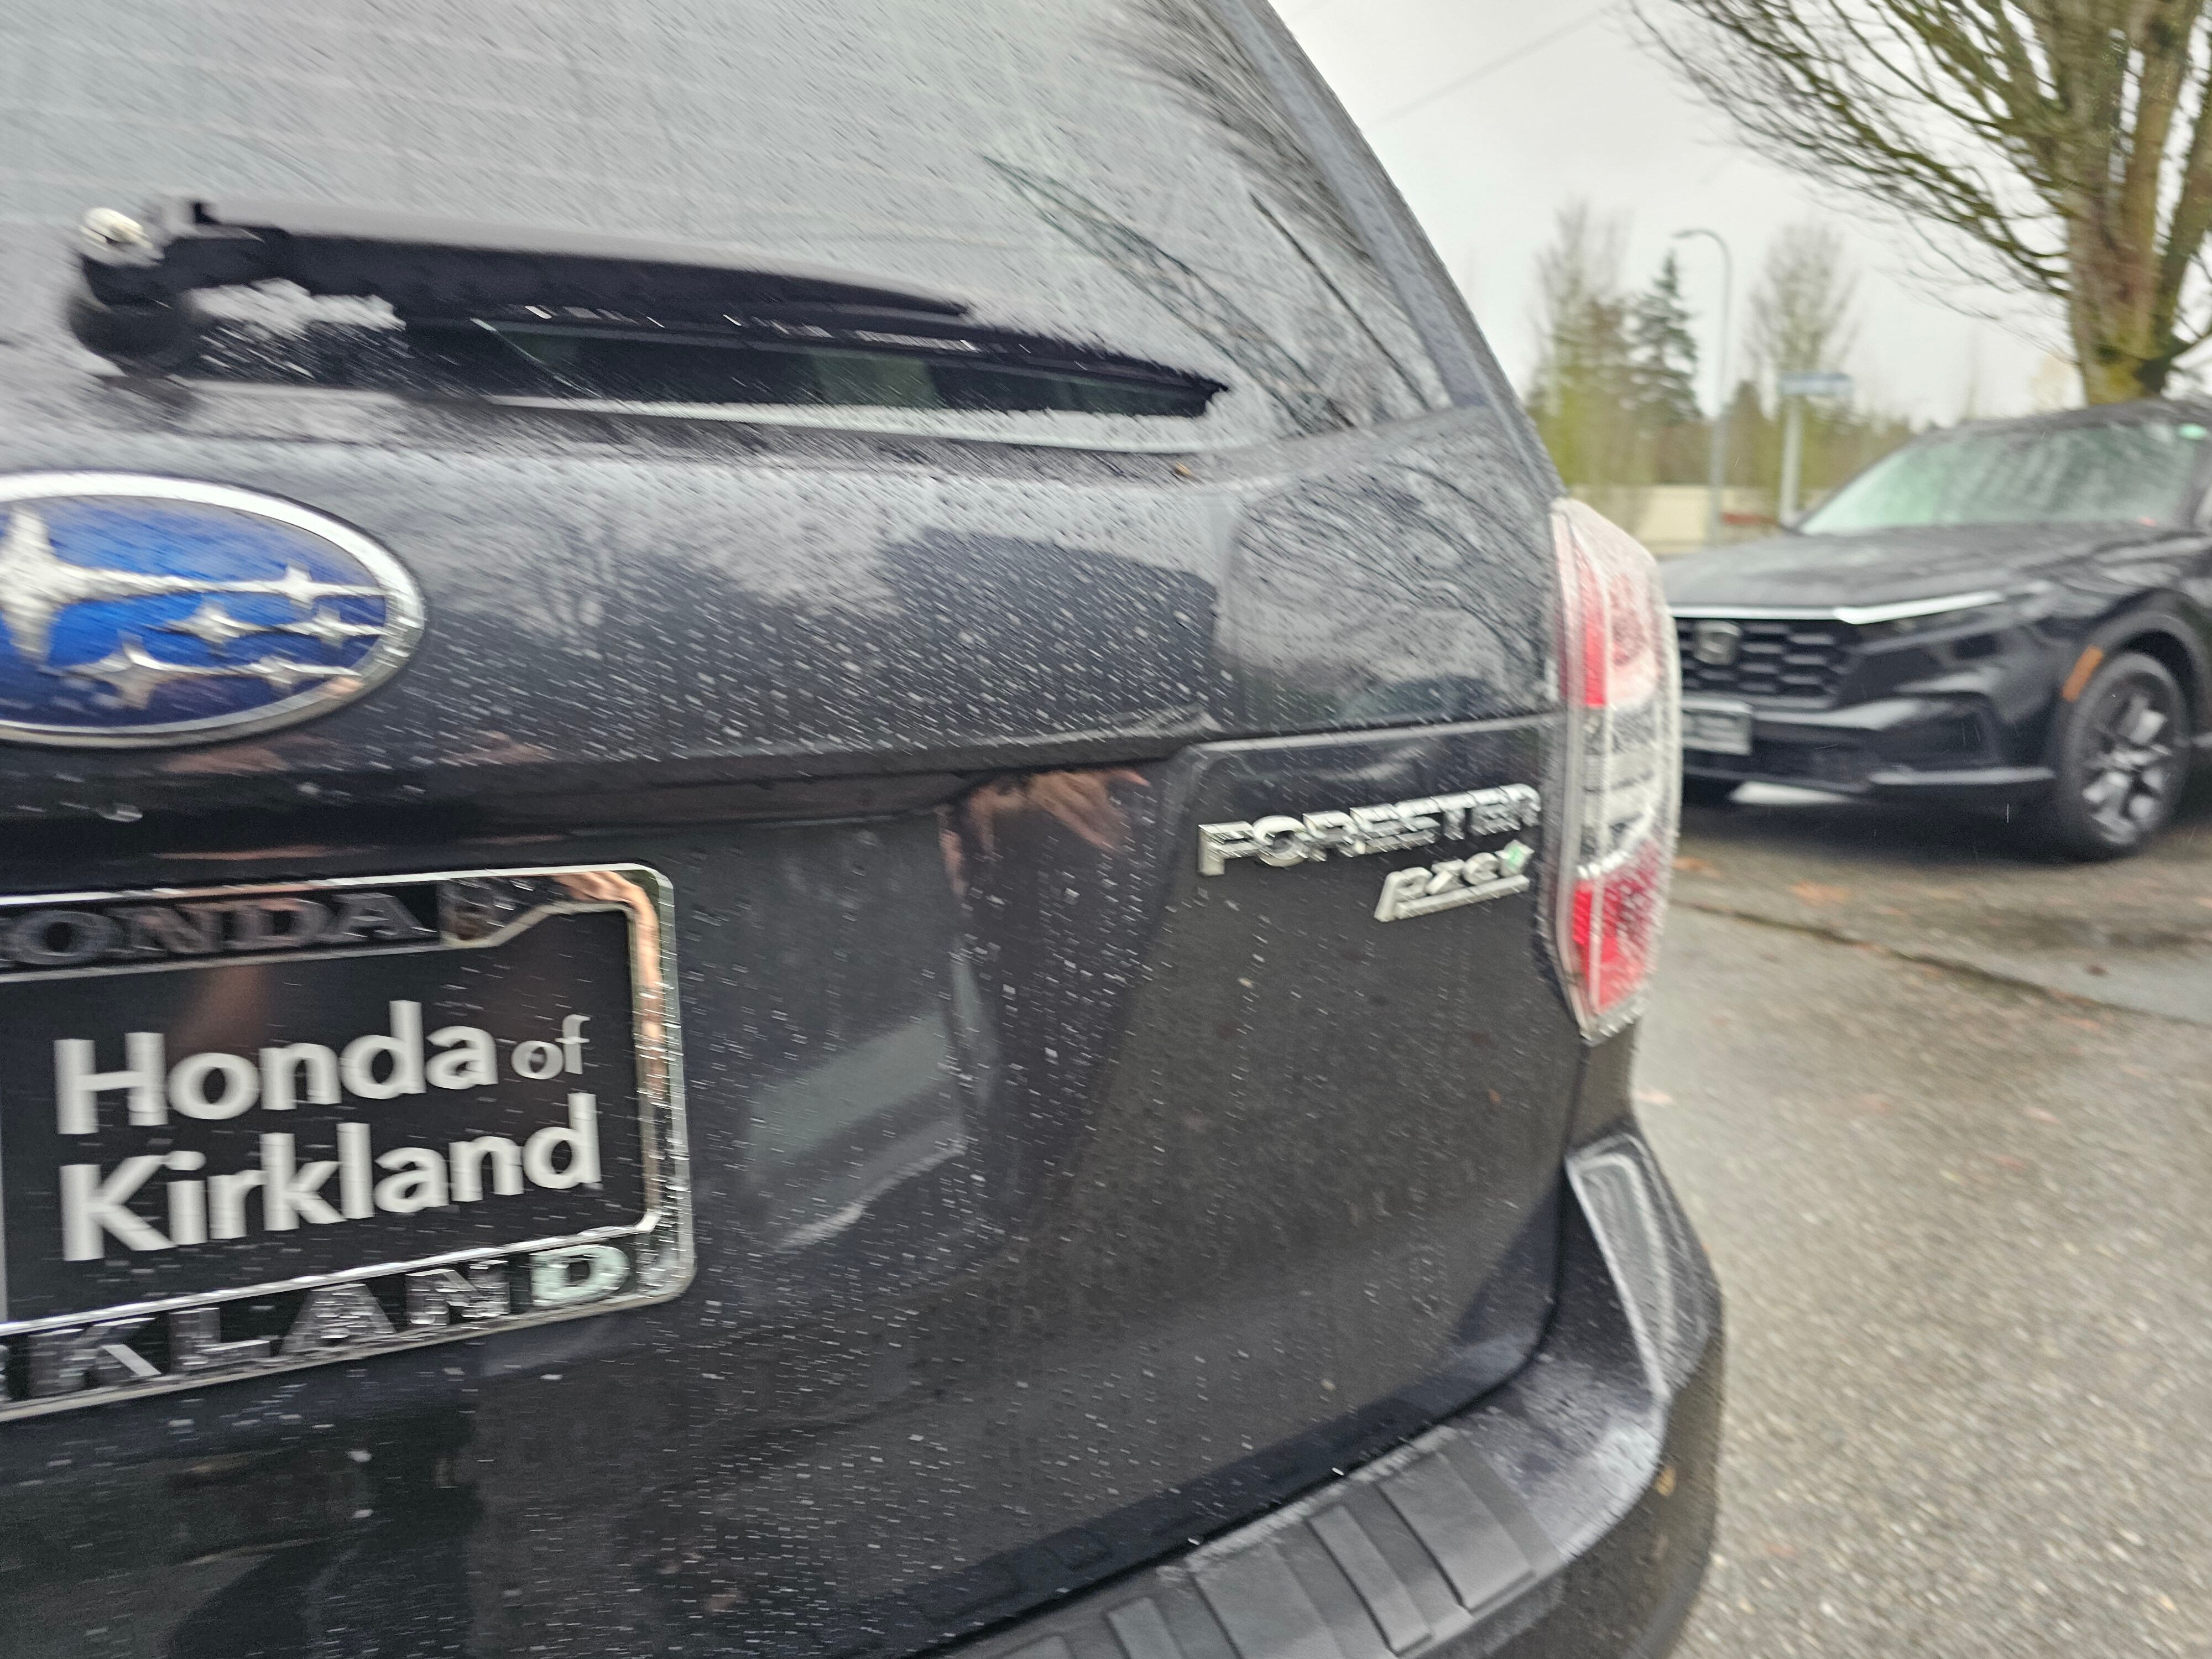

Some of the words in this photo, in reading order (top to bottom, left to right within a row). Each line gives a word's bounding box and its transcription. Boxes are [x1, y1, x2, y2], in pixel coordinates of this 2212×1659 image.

[1198, 783, 1542, 877] FORESTER
[0, 892, 432, 966] ONDA
[54, 1000, 499, 1135] Honda
[512, 1014, 590, 1079] of
[60, 1093, 602, 1261] Kirkland
[0, 1244, 628, 1401] KLAND
